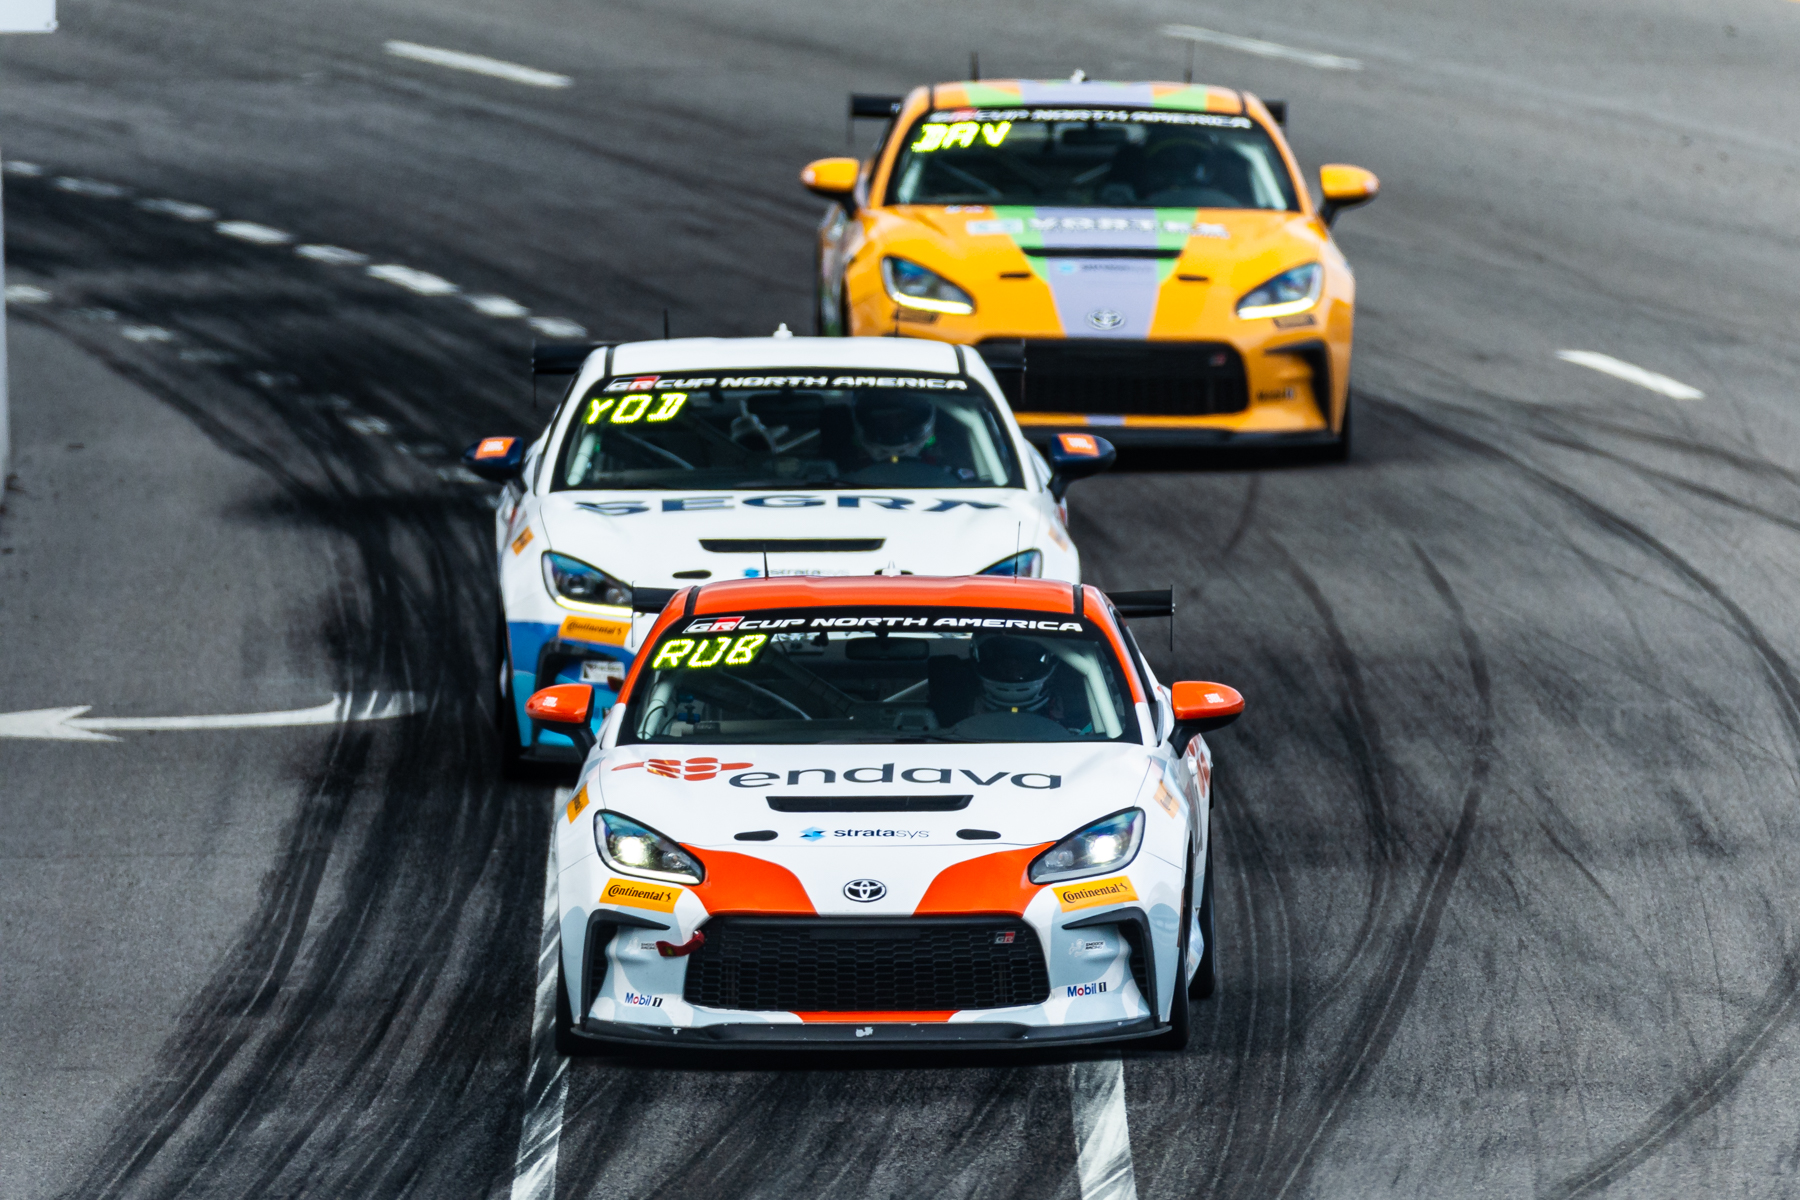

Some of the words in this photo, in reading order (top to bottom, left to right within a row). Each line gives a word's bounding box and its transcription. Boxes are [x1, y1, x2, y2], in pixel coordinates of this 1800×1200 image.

[1031, 108, 1129, 121] NORTH
[1129, 111, 1252, 129] AMERICA
[605, 377, 659, 392] GR
[654, 377, 717, 389] CUP
[719, 375, 828, 388] NORTH
[831, 376, 968, 390] AMERICA
[587, 393, 688, 424] YOD
[684, 618, 741, 633] GR
[738, 618, 806, 630] CUP
[810, 617, 928, 627] NORTH
[933, 618, 1084, 632] AMERICA
[728, 762, 1062, 790] endava
[833, 828, 929, 839] stratasys
[608, 884, 665, 901] Continental
[1062, 884, 1120, 903] Continental
[1067, 983, 1097, 997] Mobil
[624, 992, 652, 1006] Mobil
